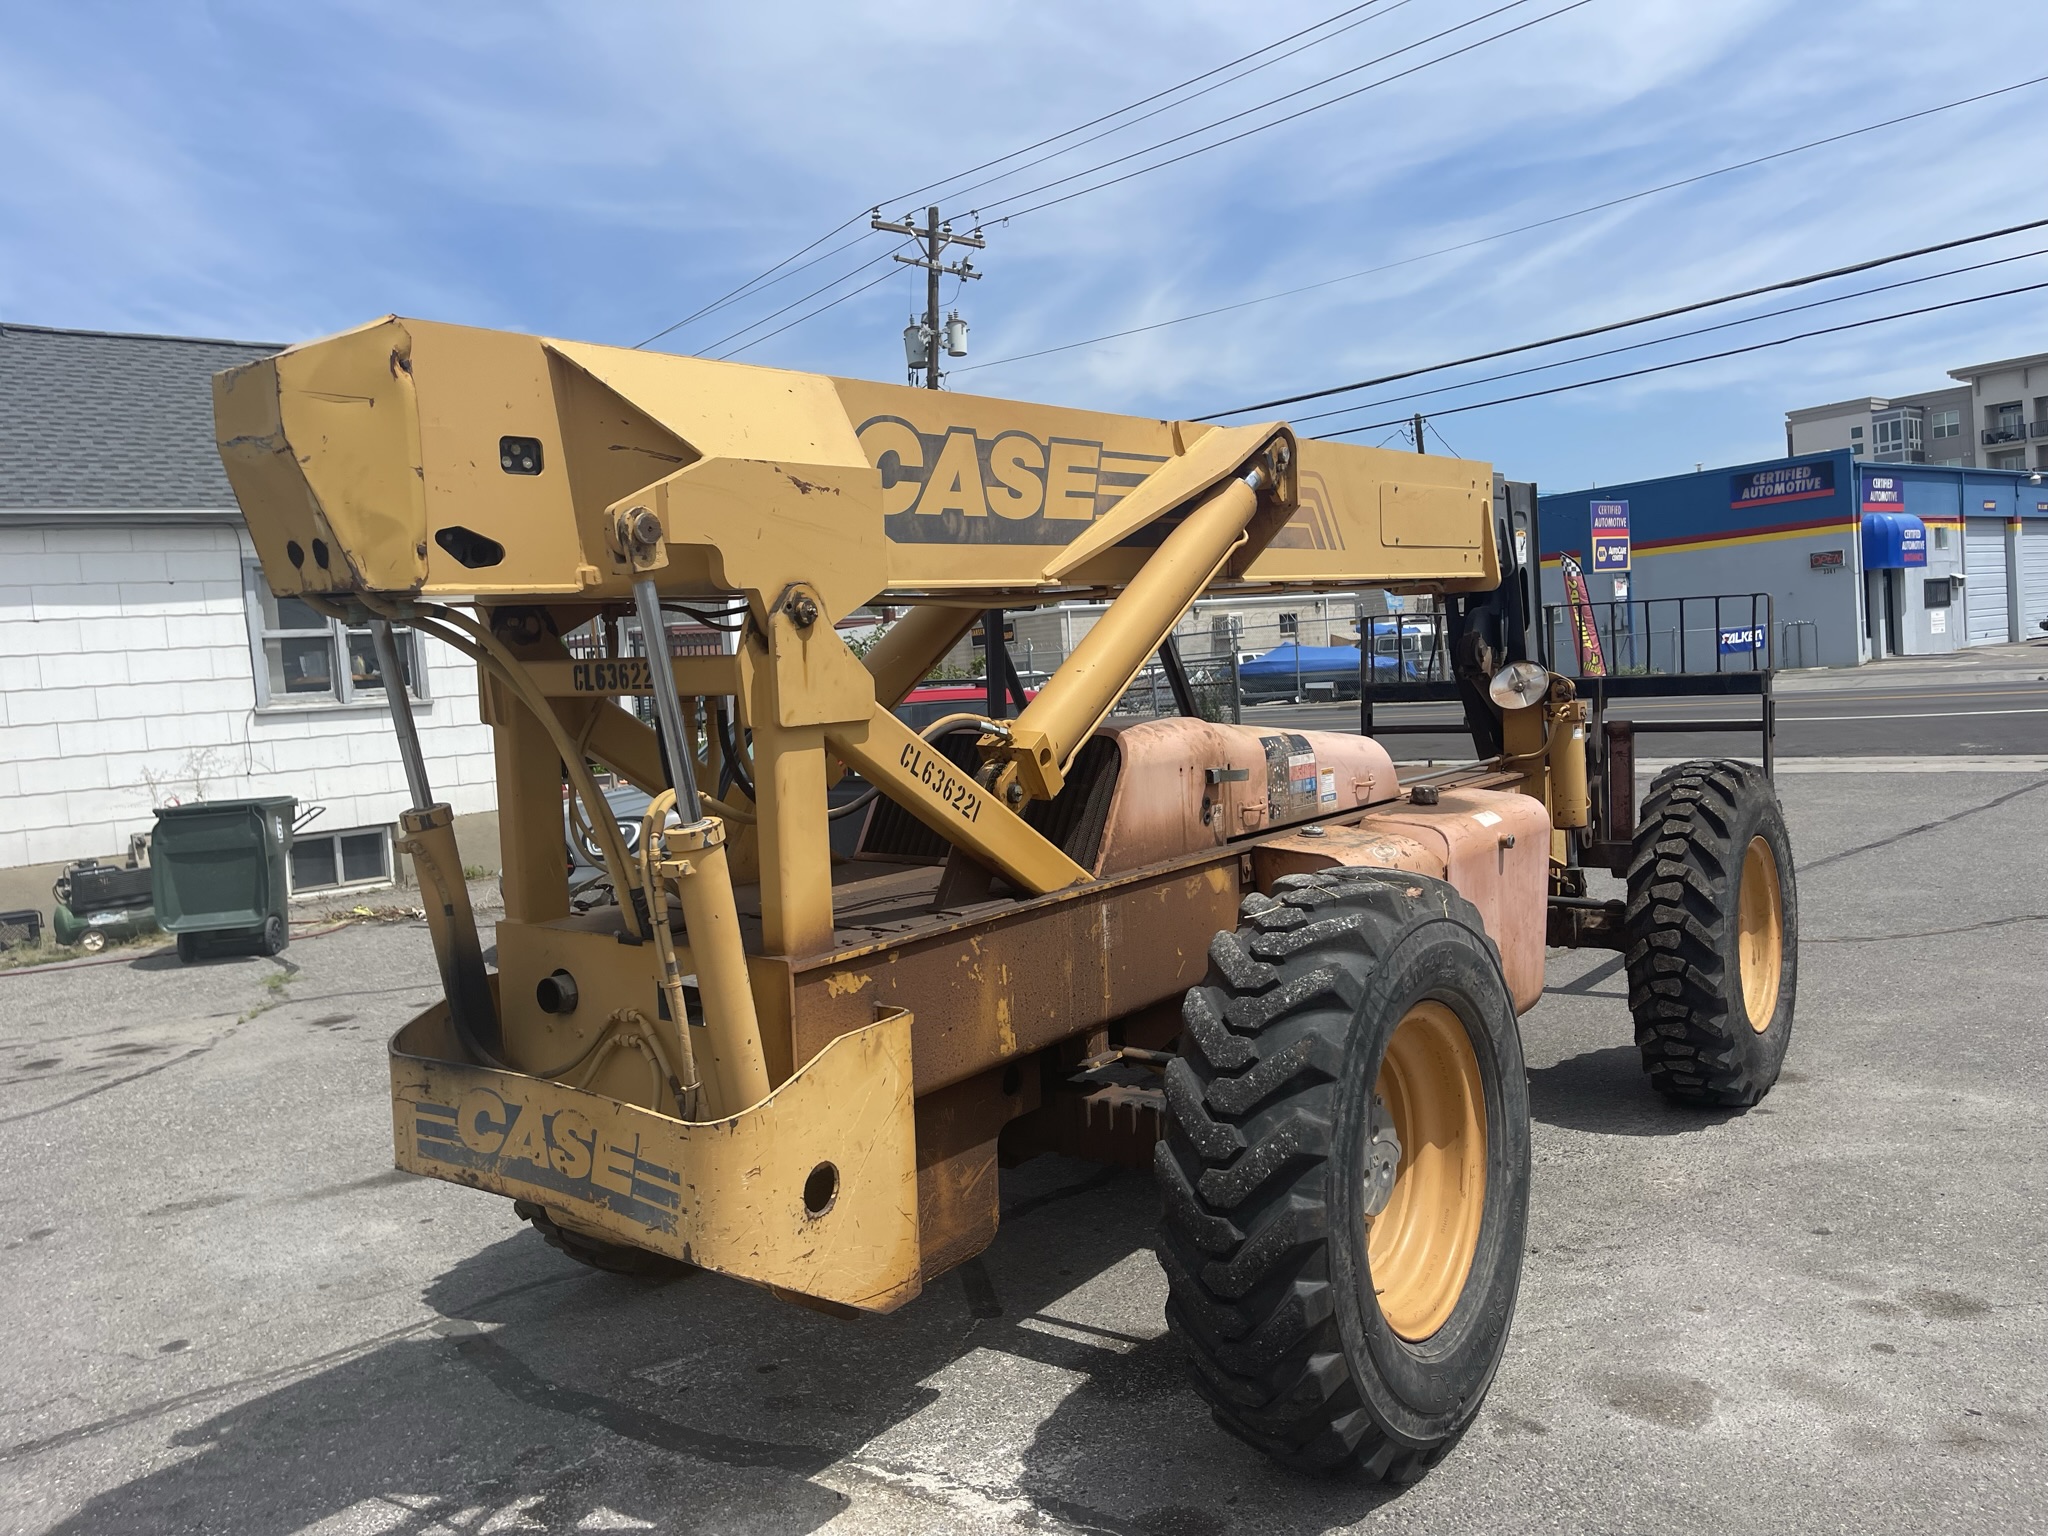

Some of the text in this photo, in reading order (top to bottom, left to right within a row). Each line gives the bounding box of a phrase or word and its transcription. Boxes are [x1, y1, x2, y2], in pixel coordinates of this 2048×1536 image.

[855, 416, 1101, 520] CASE
[1753, 466, 1811, 485] CERTIFIED
[1742, 477, 1821, 500] AUTOMOTIVE
[1872, 478, 1894, 489] CERTIFIED
[1870, 491, 1898, 502] AUTOMOTIVE
[1598, 504, 1622, 514] CERTIFIED
[1594, 517, 1627, 528] AUTOMOTIVE
[1812, 553, 1842, 566] OPEN
[573, 662, 654, 692] CL63622
[900, 743, 982, 823] CL636221
[457, 1088, 636, 1198] CASE
